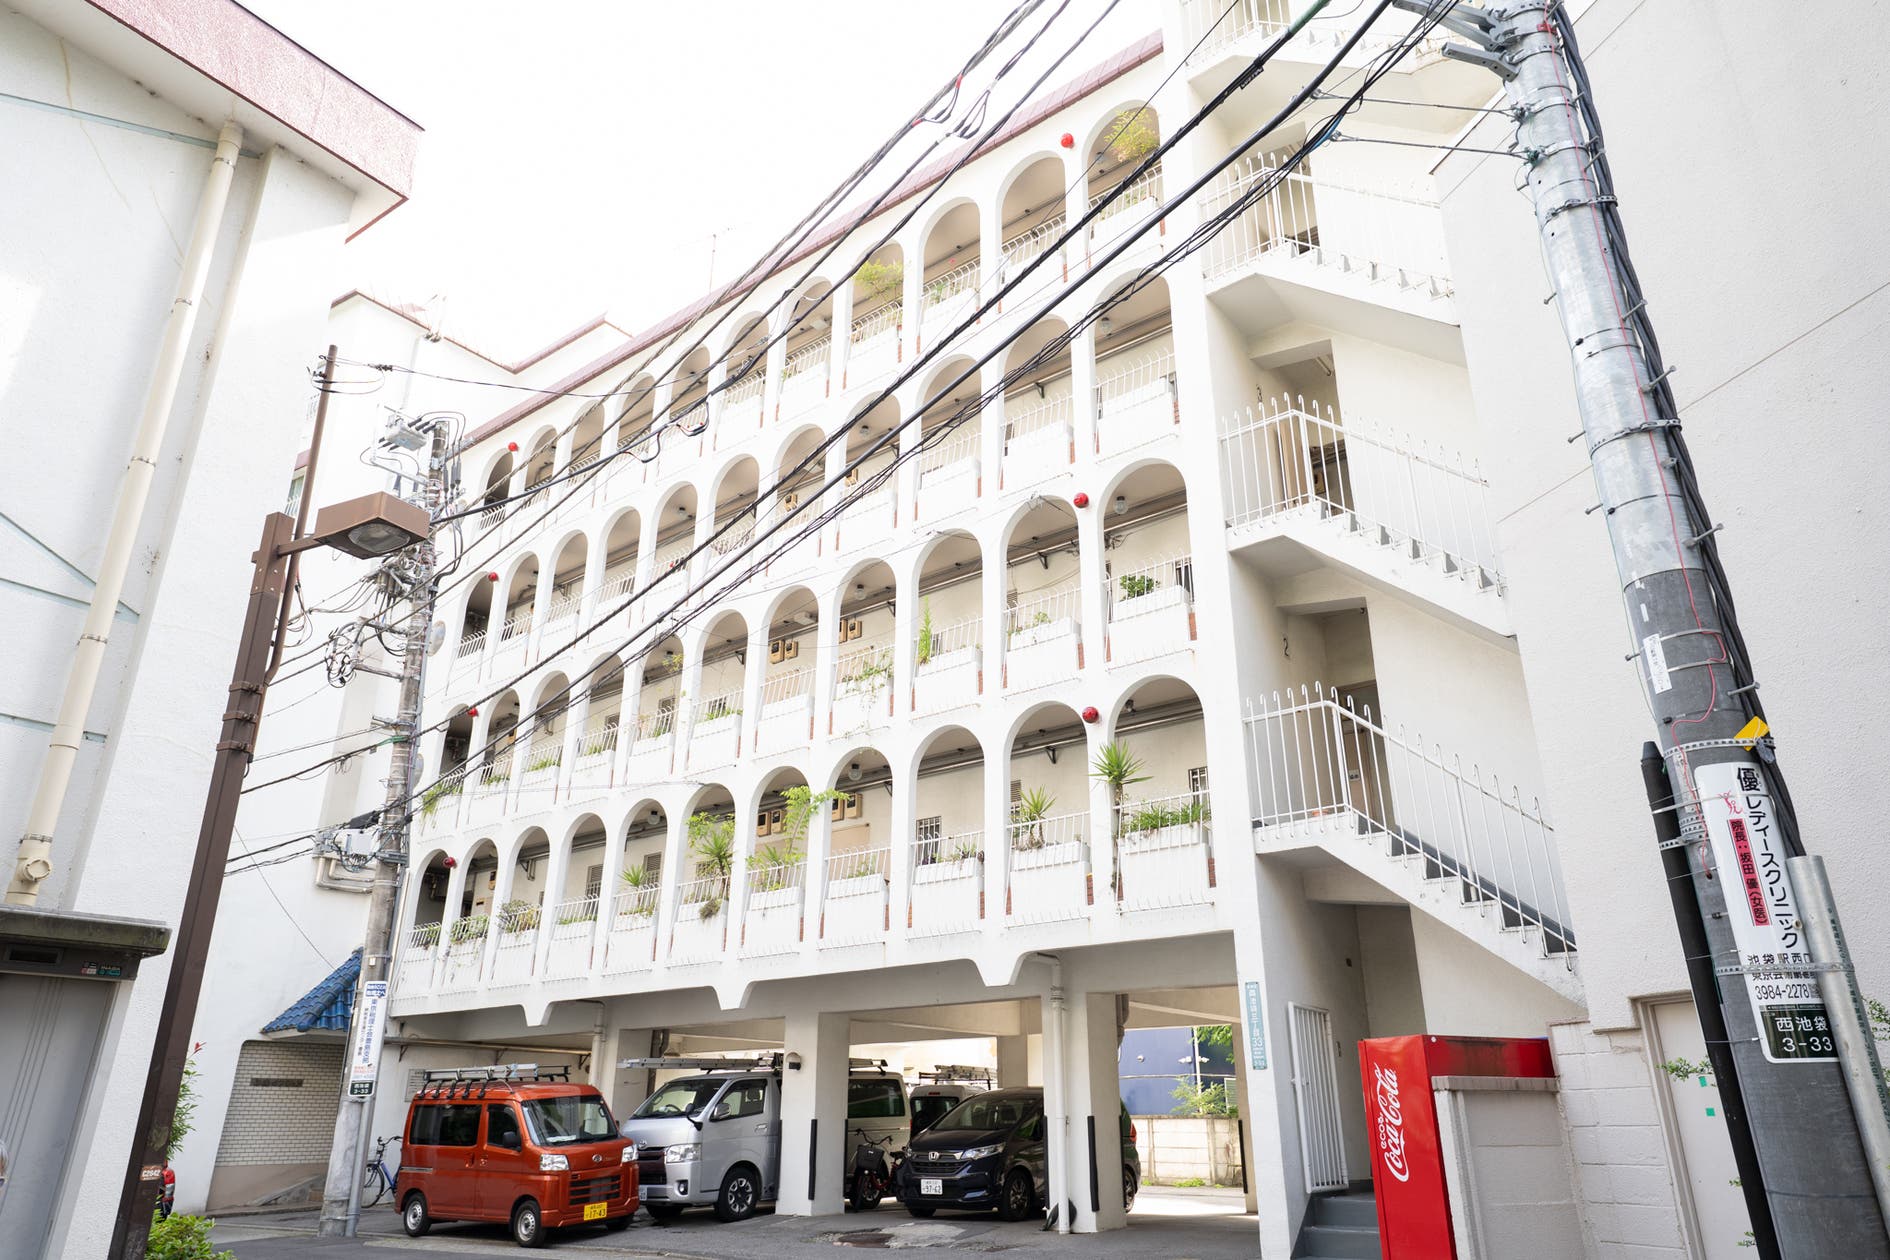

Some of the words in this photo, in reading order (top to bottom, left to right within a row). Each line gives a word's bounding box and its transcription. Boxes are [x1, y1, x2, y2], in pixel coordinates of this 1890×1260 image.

[1755, 983, 1810, 1000] 3984-2278
[1775, 1015, 1829, 1032] 西池袋
[1782, 1036, 1833, 1052] 3-33
[1373, 1062, 1410, 1182] Coca-Cola
